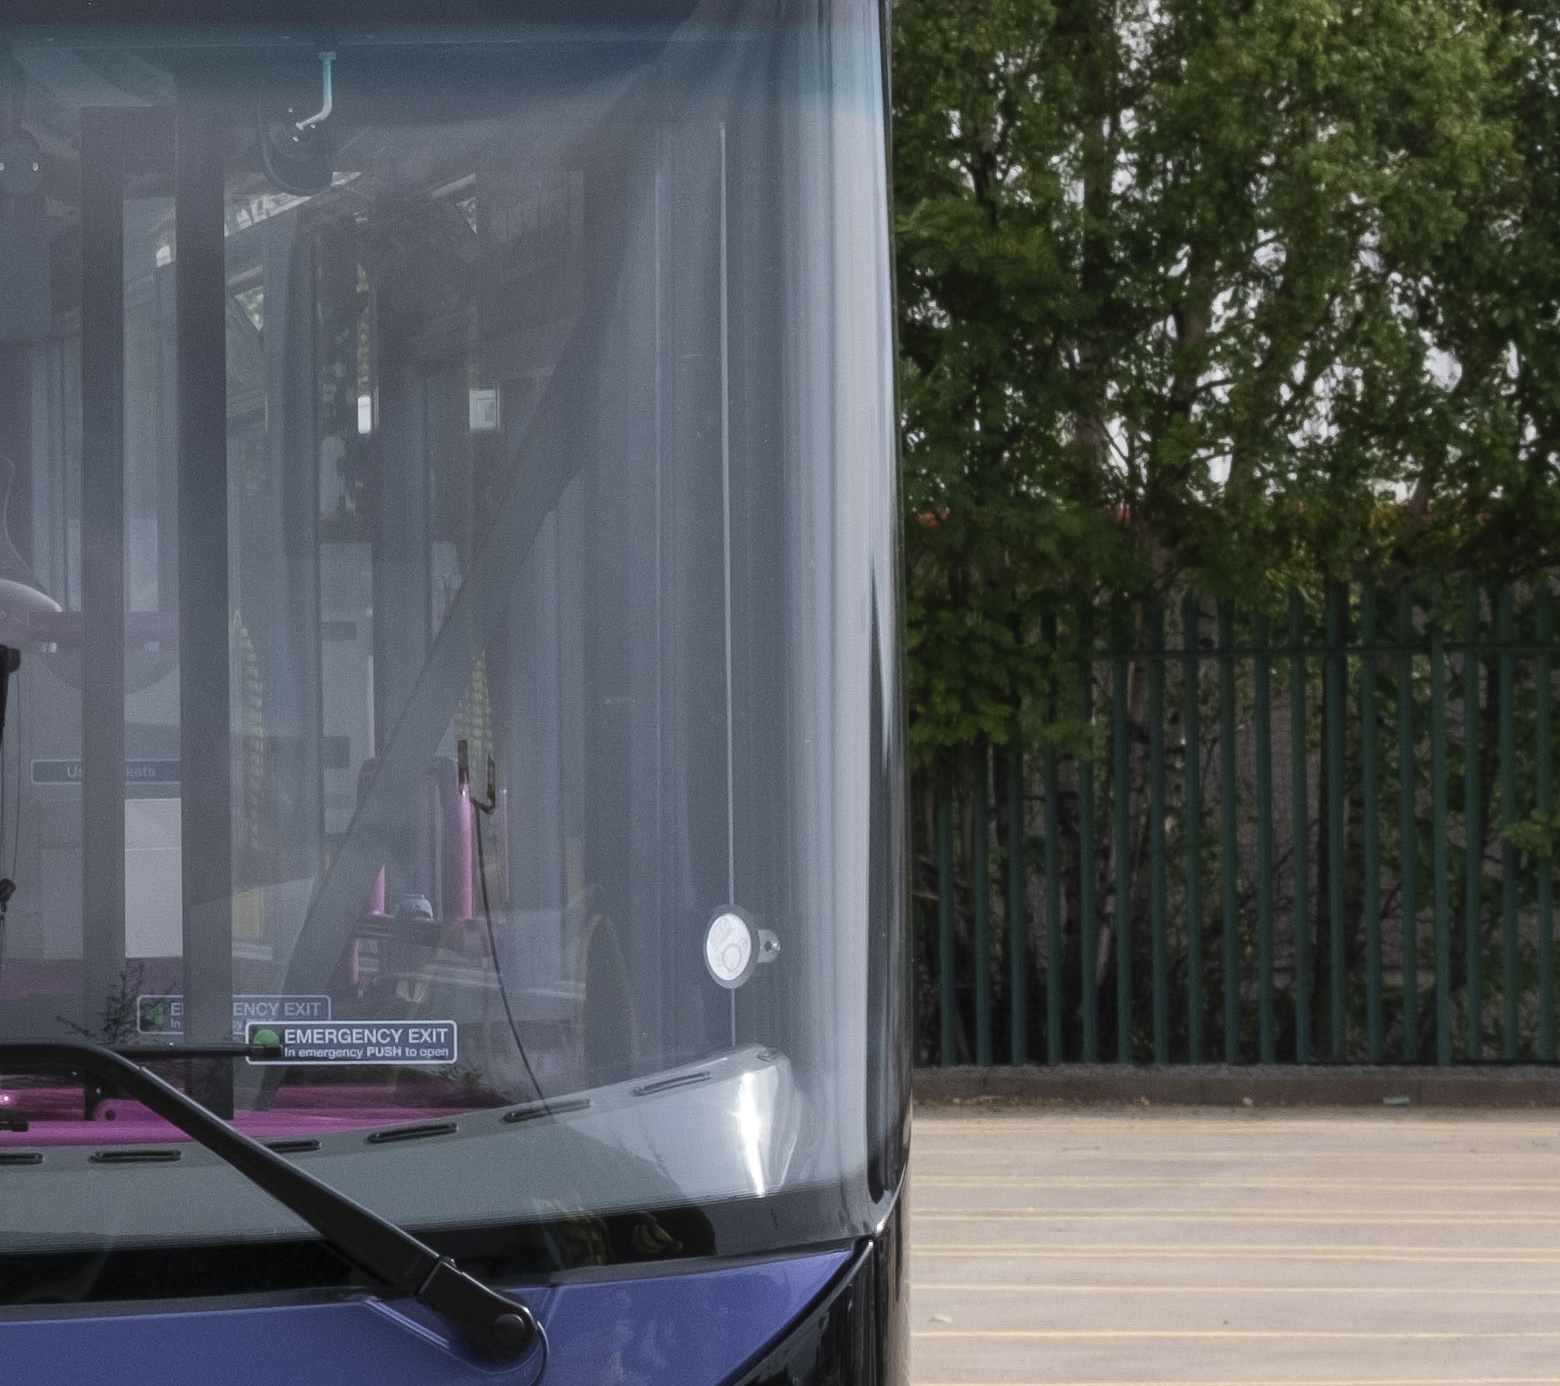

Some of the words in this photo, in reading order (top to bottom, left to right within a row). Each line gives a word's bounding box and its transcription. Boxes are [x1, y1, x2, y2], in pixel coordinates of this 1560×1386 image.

[284, 1001, 322, 1015] EXIT
[284, 1028, 404, 1044] EMERGENCY
[408, 1028, 449, 1043] EXIT
[284, 1047, 296, 1057] In
[298, 1048, 363, 1059] emergency
[366, 1046, 402, 1057] PUSH
[405, 1046, 418, 1057] to
[419, 1048, 449, 1059] open
